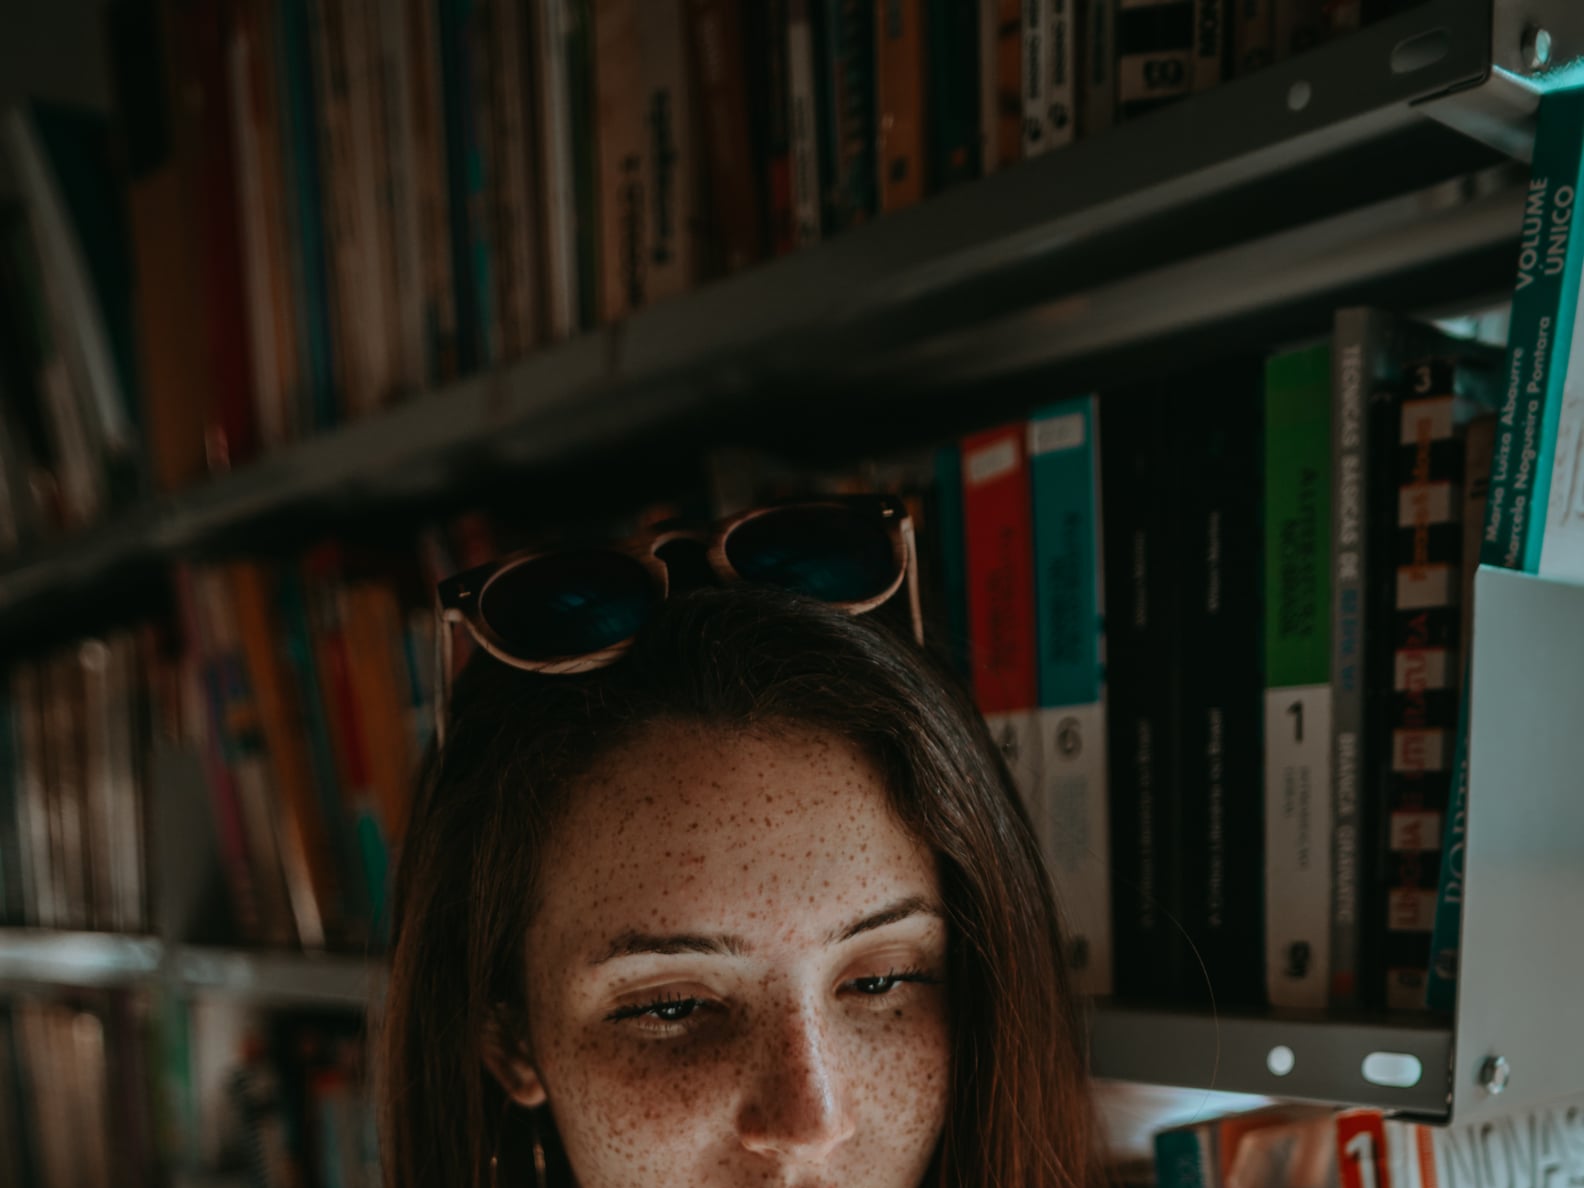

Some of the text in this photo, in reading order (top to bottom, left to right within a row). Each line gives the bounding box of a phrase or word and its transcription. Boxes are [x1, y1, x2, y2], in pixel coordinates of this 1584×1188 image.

[1516, 177, 1548, 290] VOLUME
[1538, 184, 1575, 276] ÚNICO
[1413, 367, 1432, 393] 3
[1485, 347, 1524, 542] Maria Luiza Abaurre
[1506, 316, 1551, 568] Marcela Nogueira Pontara
[1287, 701, 1304, 741] 1
